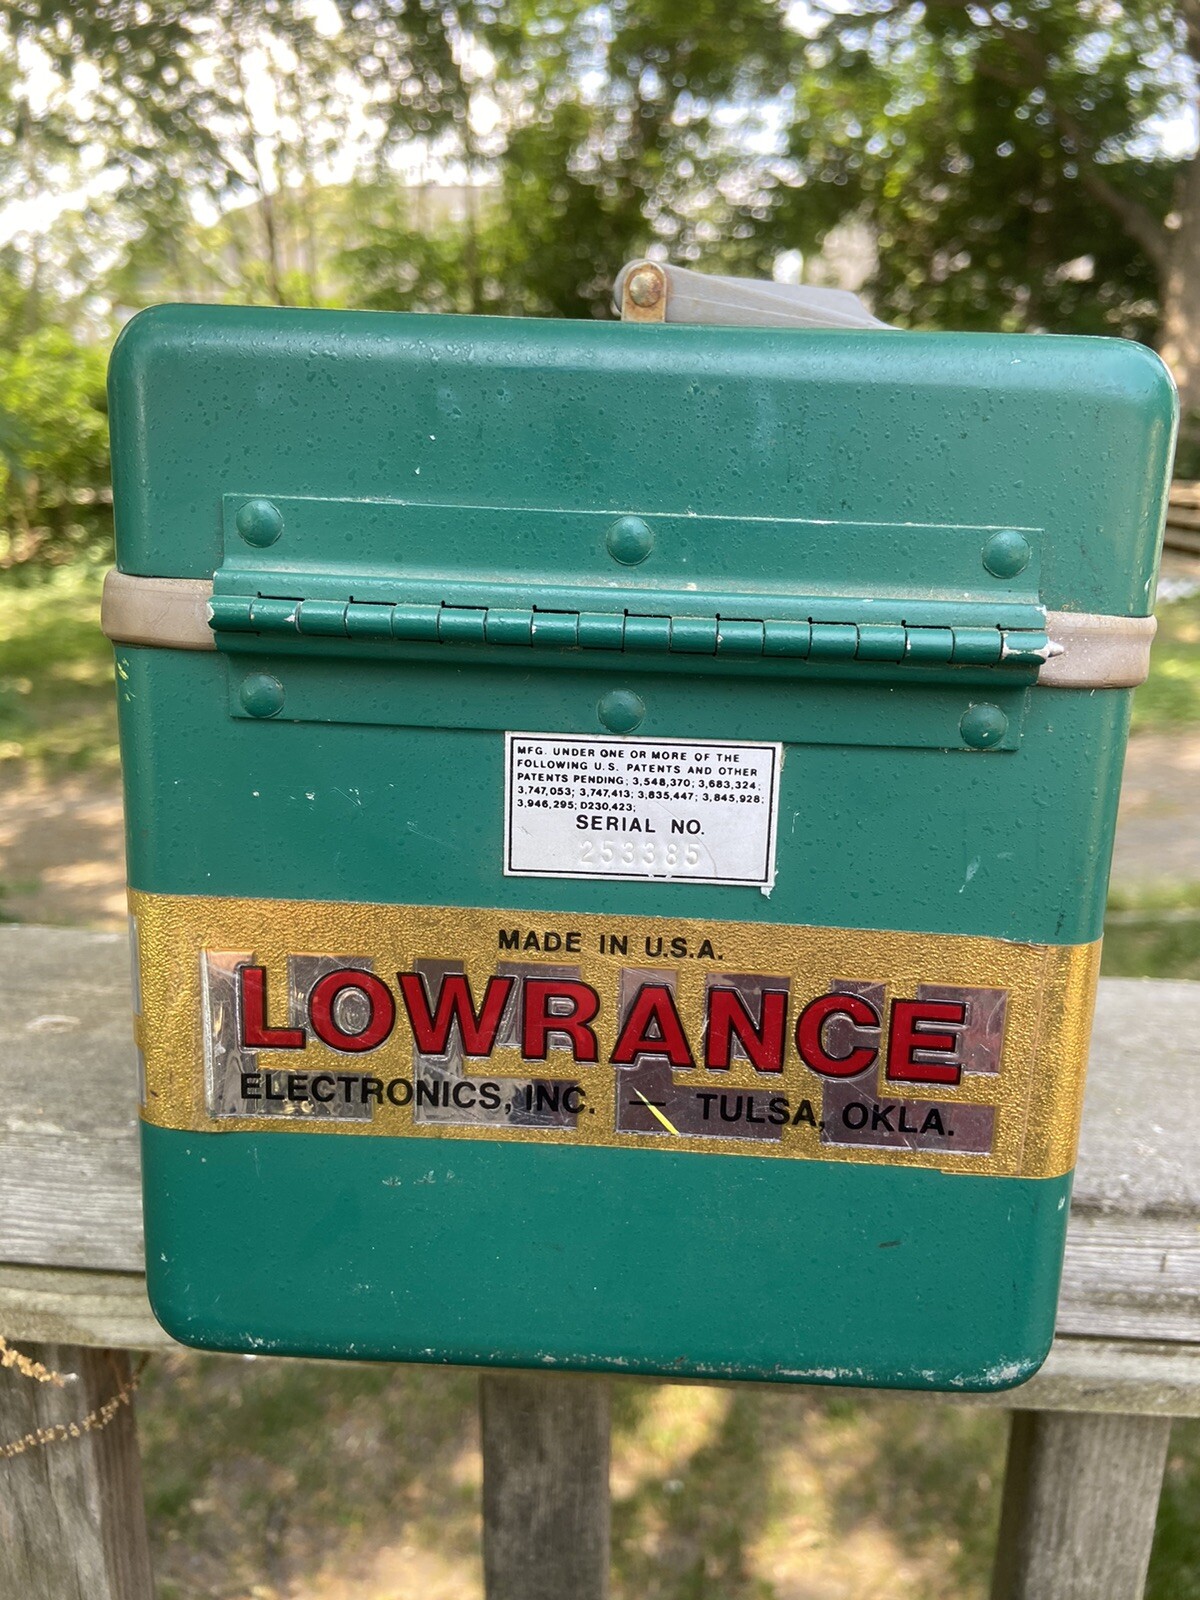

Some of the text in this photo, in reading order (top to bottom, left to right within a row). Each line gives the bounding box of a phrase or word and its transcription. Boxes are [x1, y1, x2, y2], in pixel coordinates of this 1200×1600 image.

[517, 746, 740, 762] MFG. UNDER ONE OR MORE OF THE
[517, 759, 757, 776] FOLLOWING U.S. PATENTS AND OTHER
[517, 773, 568, 782] PATENTS
[576, 814, 705, 835] SERIAL NO.
[580, 840, 700, 865] 253385
[498, 929, 724, 960] MADE IN U.S.A.
[239, 963, 967, 1086] LOWRANCE
[240, 1073, 511, 1115] ELECTRONICS,
[525, 1084, 595, 1114] INC.
[696, 1093, 825, 1132] TULSA,
[842, 1102, 954, 1137] OKLA.
